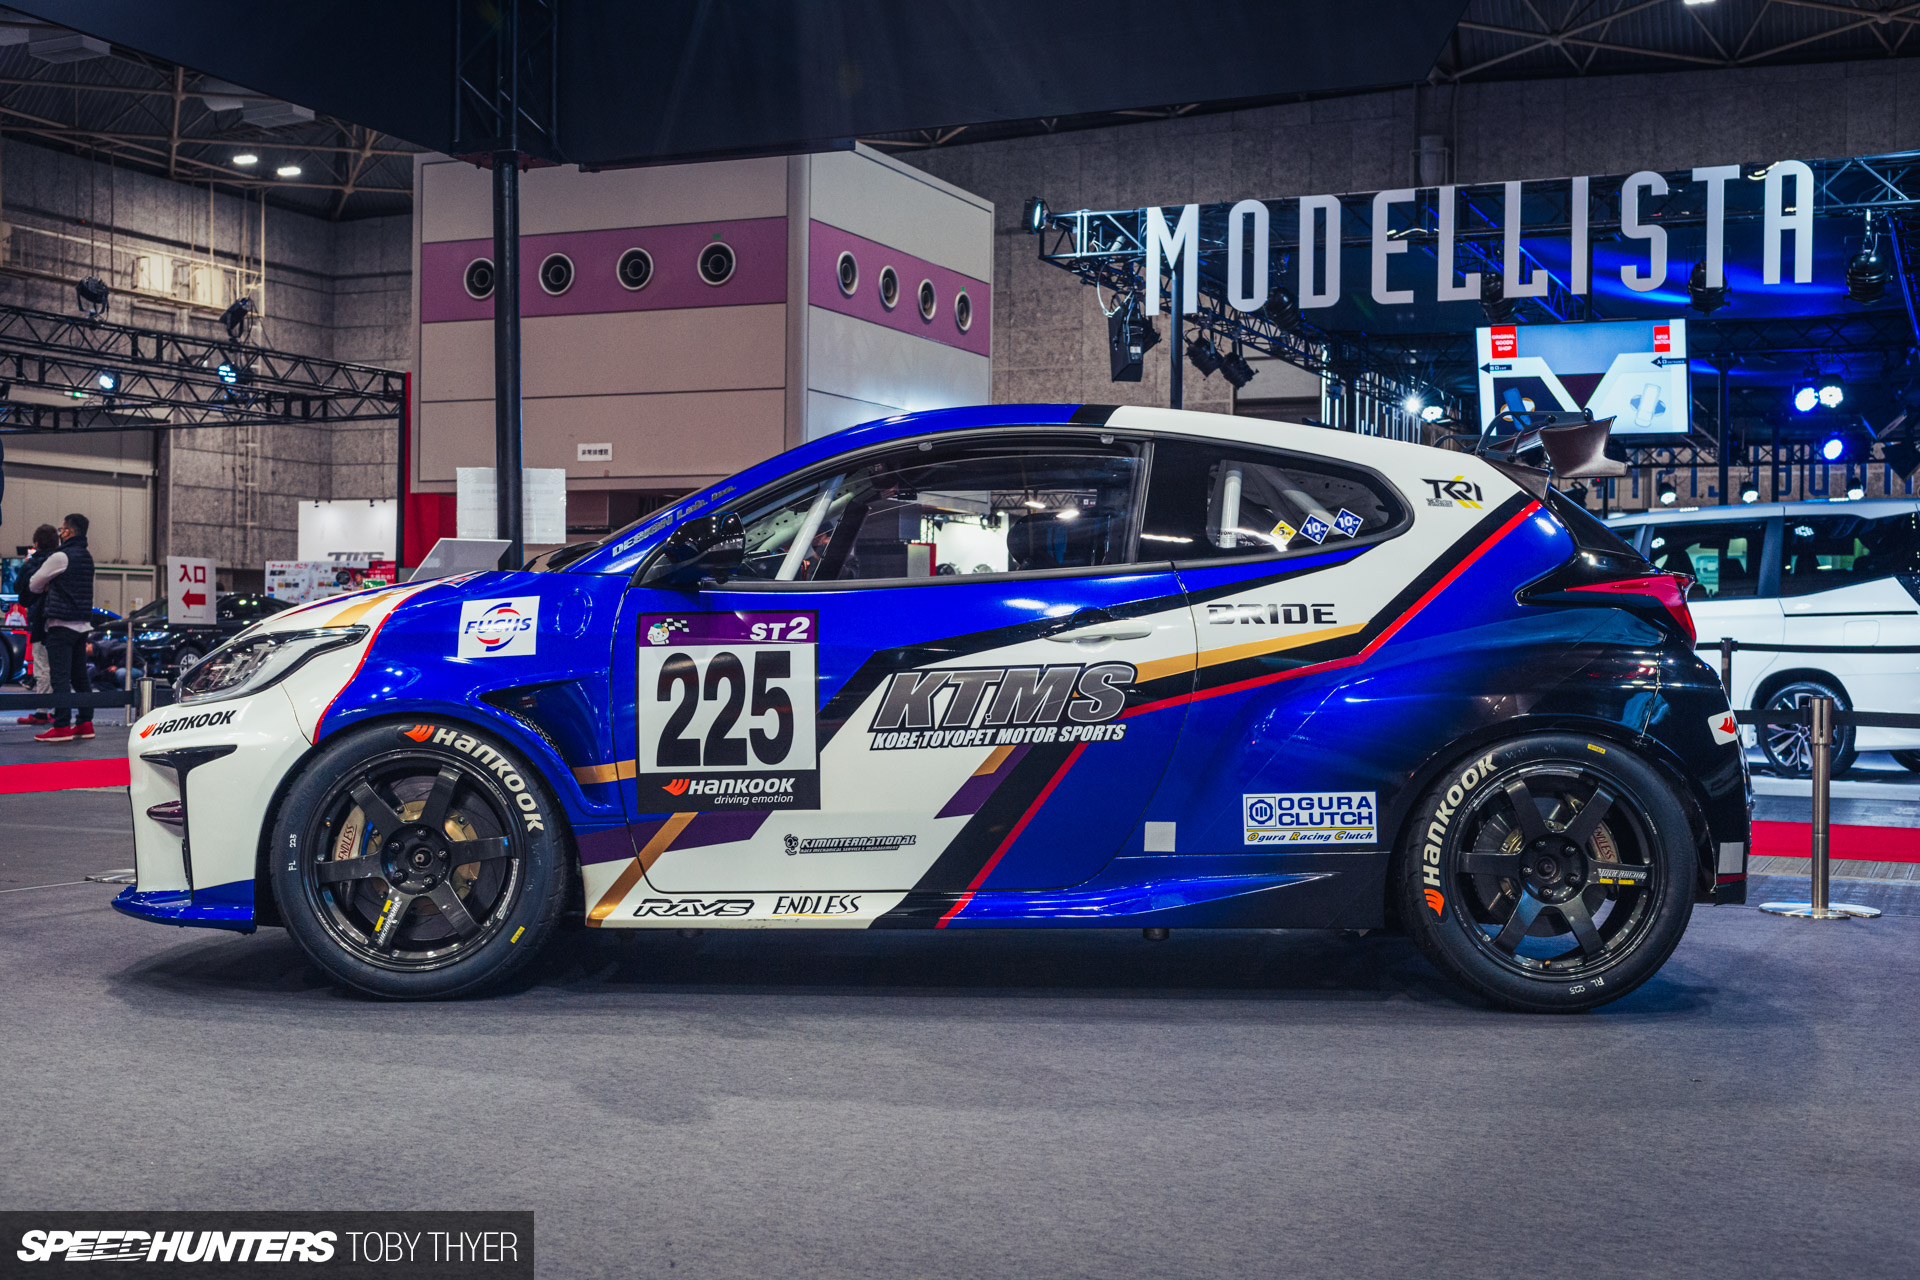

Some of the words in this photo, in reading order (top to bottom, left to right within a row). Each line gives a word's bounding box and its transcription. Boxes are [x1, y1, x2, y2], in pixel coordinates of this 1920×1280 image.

[1146, 160, 1815, 316] MODELLISTA
[612, 515, 673, 557] DESIGN
[179, 564, 206, 584] 入口
[1207, 604, 1337, 624] BRIDE
[464, 618, 532, 634] FUCHS
[871, 662, 1137, 731] KTMS
[656, 651, 794, 767] 225
[873, 731, 918, 749] KOBE
[920, 728, 995, 748] TOYOPET
[995, 727, 1055, 745] MOTOR
[1056, 724, 1126, 742] SPORTS
[714, 795, 749, 805] driving
[752, 794, 793, 803] emotion
[1278, 796, 1372, 811] OGURA
[1278, 812, 1373, 826] CLUTCH
[338, 824, 355, 860] ENDLESS
[1247, 833, 1286, 843] Ogura
[1289, 832, 1332, 842] Racing
[633, 899, 755, 917] RAYS
[772, 895, 862, 914] ENDLESS
